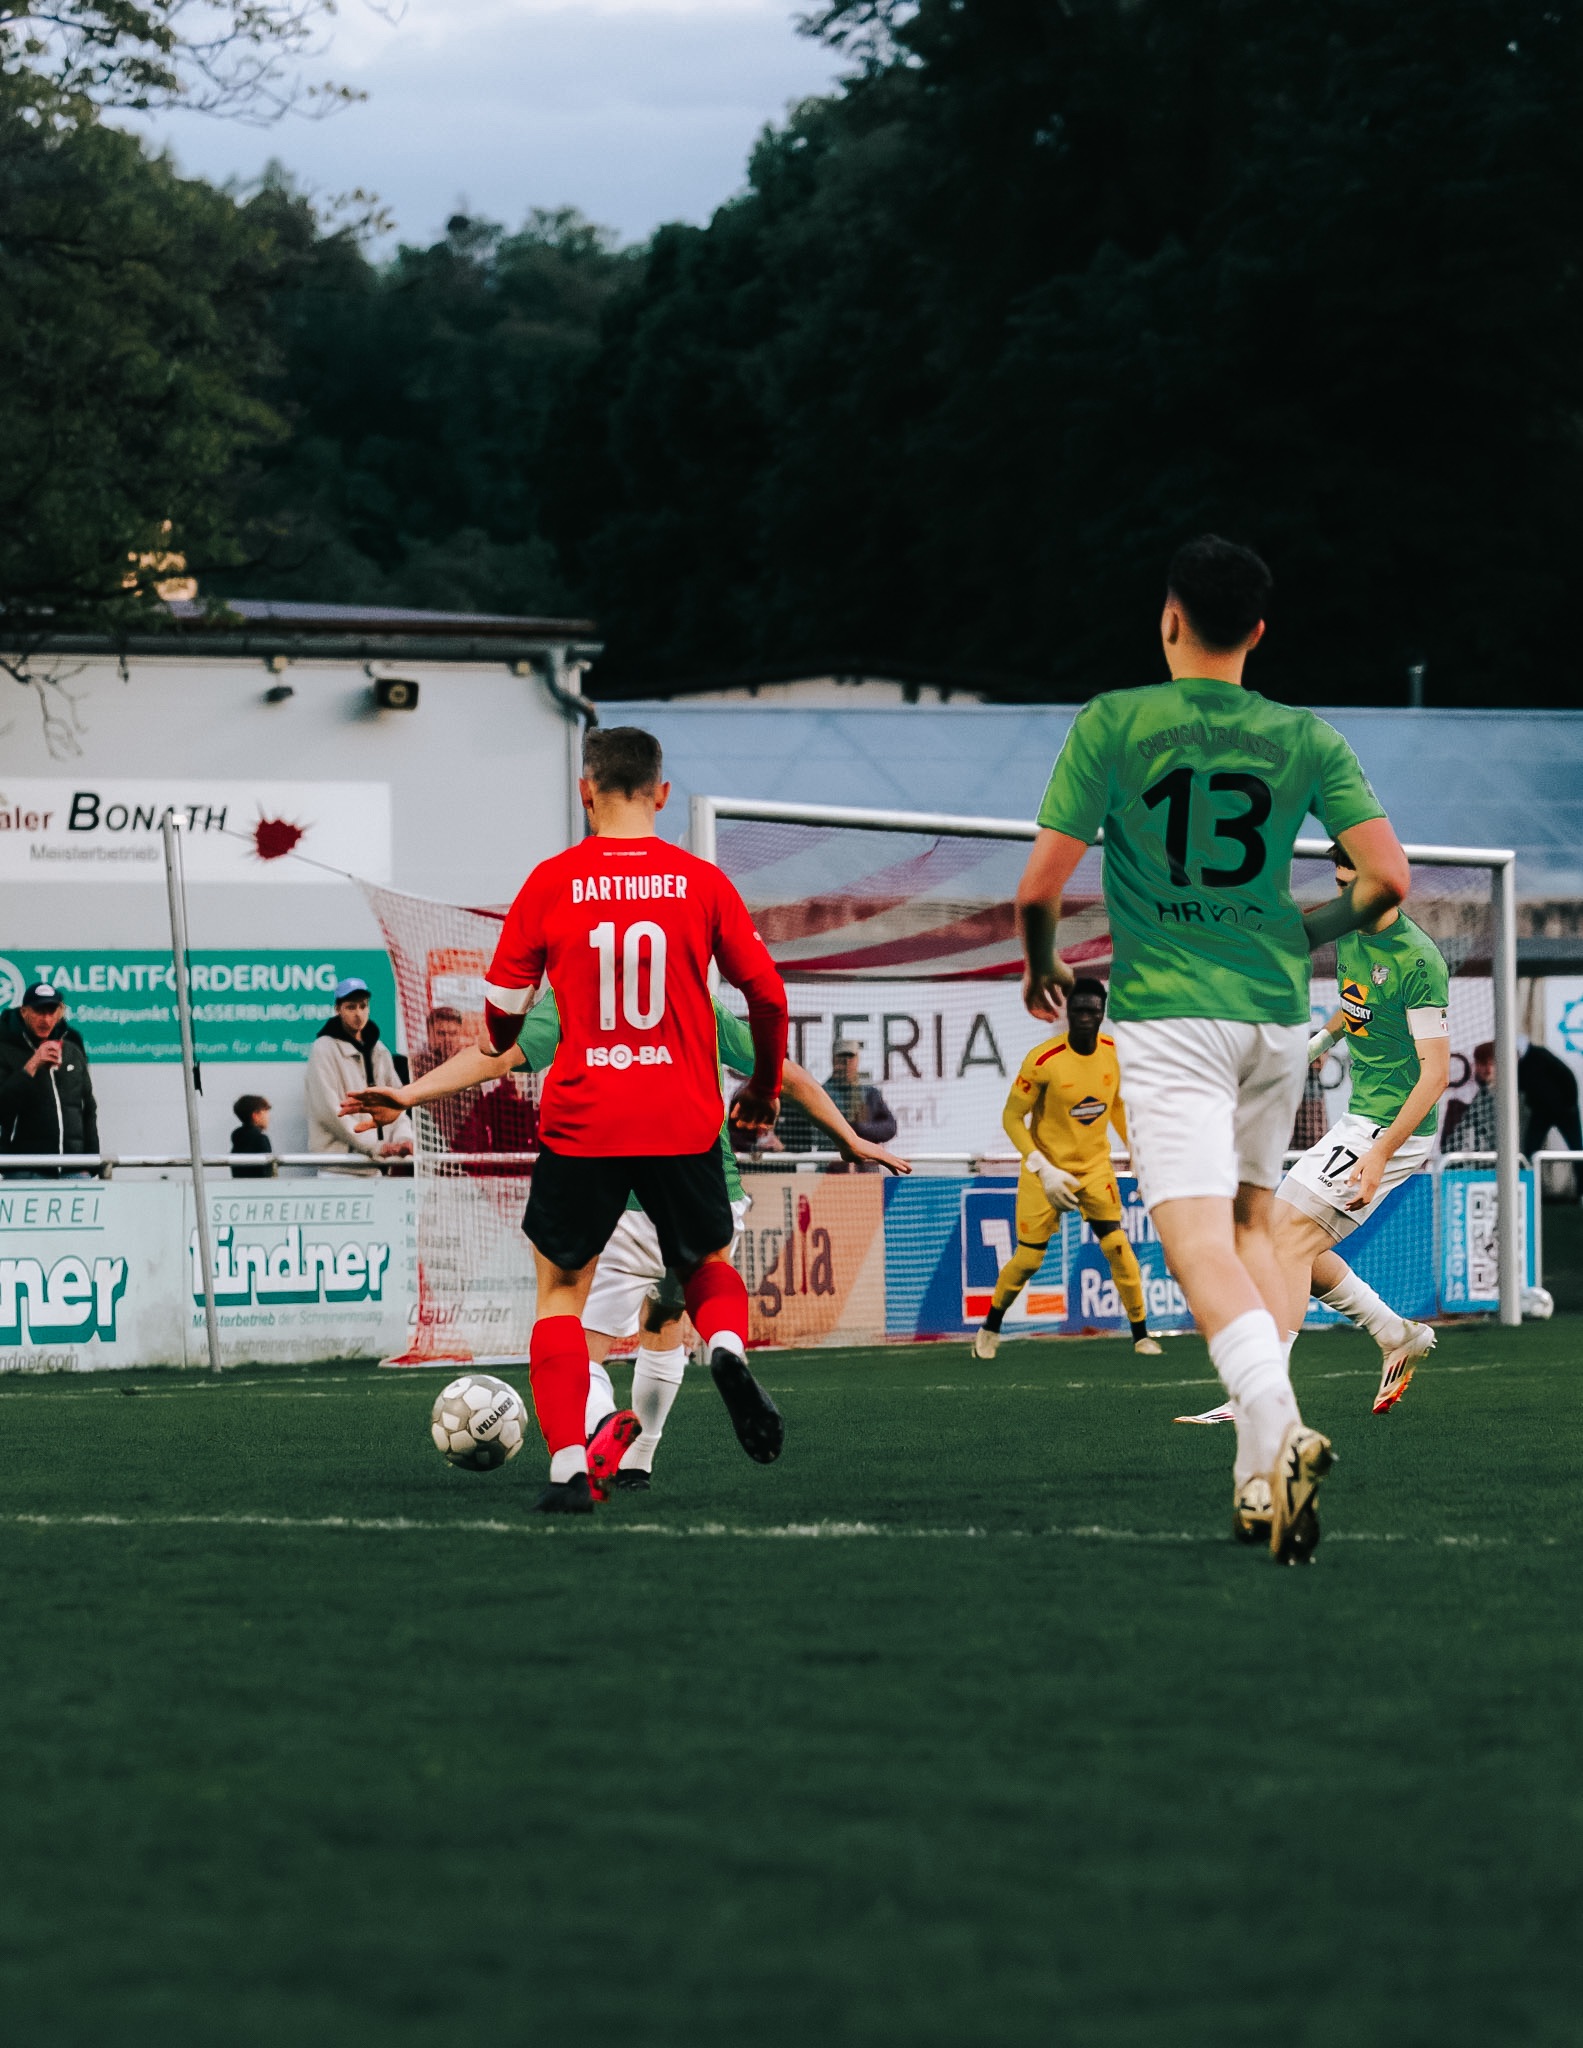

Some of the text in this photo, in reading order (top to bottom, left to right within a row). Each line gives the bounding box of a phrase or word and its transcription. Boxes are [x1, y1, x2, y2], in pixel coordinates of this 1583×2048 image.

[68, 792, 228, 832] BONATH
[1141, 767, 1273, 888] 13
[30, 844, 160, 862] Meisterbetrieb
[572, 874, 687, 903] BARTHUBER
[589, 920, 667, 1030] 10
[586, 1043, 673, 1070] ISO-BA
[727, 1013, 1007, 1081] TERIA
[1321, 1145, 1359, 1179] 17
[1317, 1175, 1333, 1188] JAKO
[0, 1198, 99, 1223] NEREI
[213, 1202, 371, 1222] SCHREINEREI
